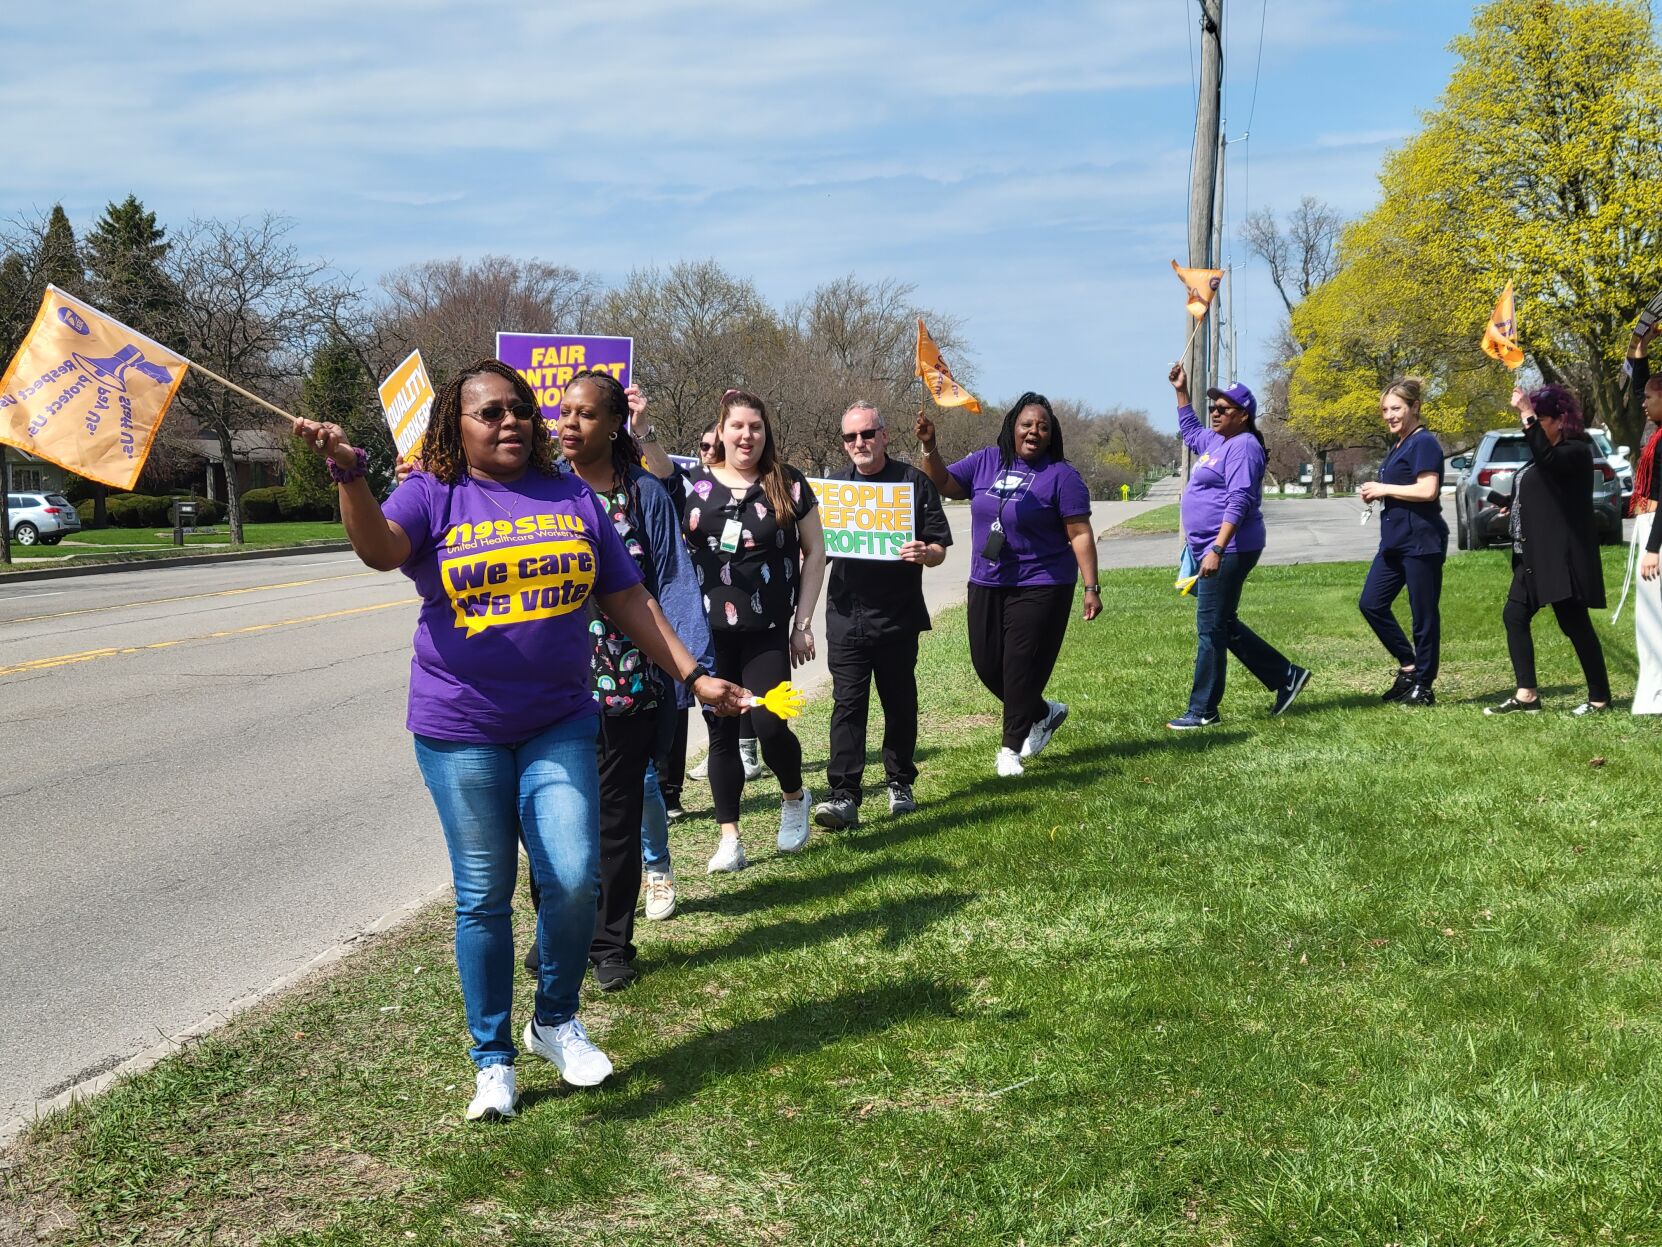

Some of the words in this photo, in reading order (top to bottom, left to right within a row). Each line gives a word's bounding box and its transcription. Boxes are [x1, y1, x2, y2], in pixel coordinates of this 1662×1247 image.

[531, 345, 586, 367] FAIR
[517, 362, 625, 387] NTRT
[387, 362, 426, 431] QUALITY
[533, 387, 566, 408] NO
[808, 482, 912, 509] PEOPLE
[446, 540, 478, 554] United
[480, 533, 535, 547] Healthcare
[822, 529, 913, 556] ROFITS
[448, 560, 508, 592] We
[518, 551, 593, 579] care
[456, 591, 511, 618] We
[520, 580, 589, 612] vote
